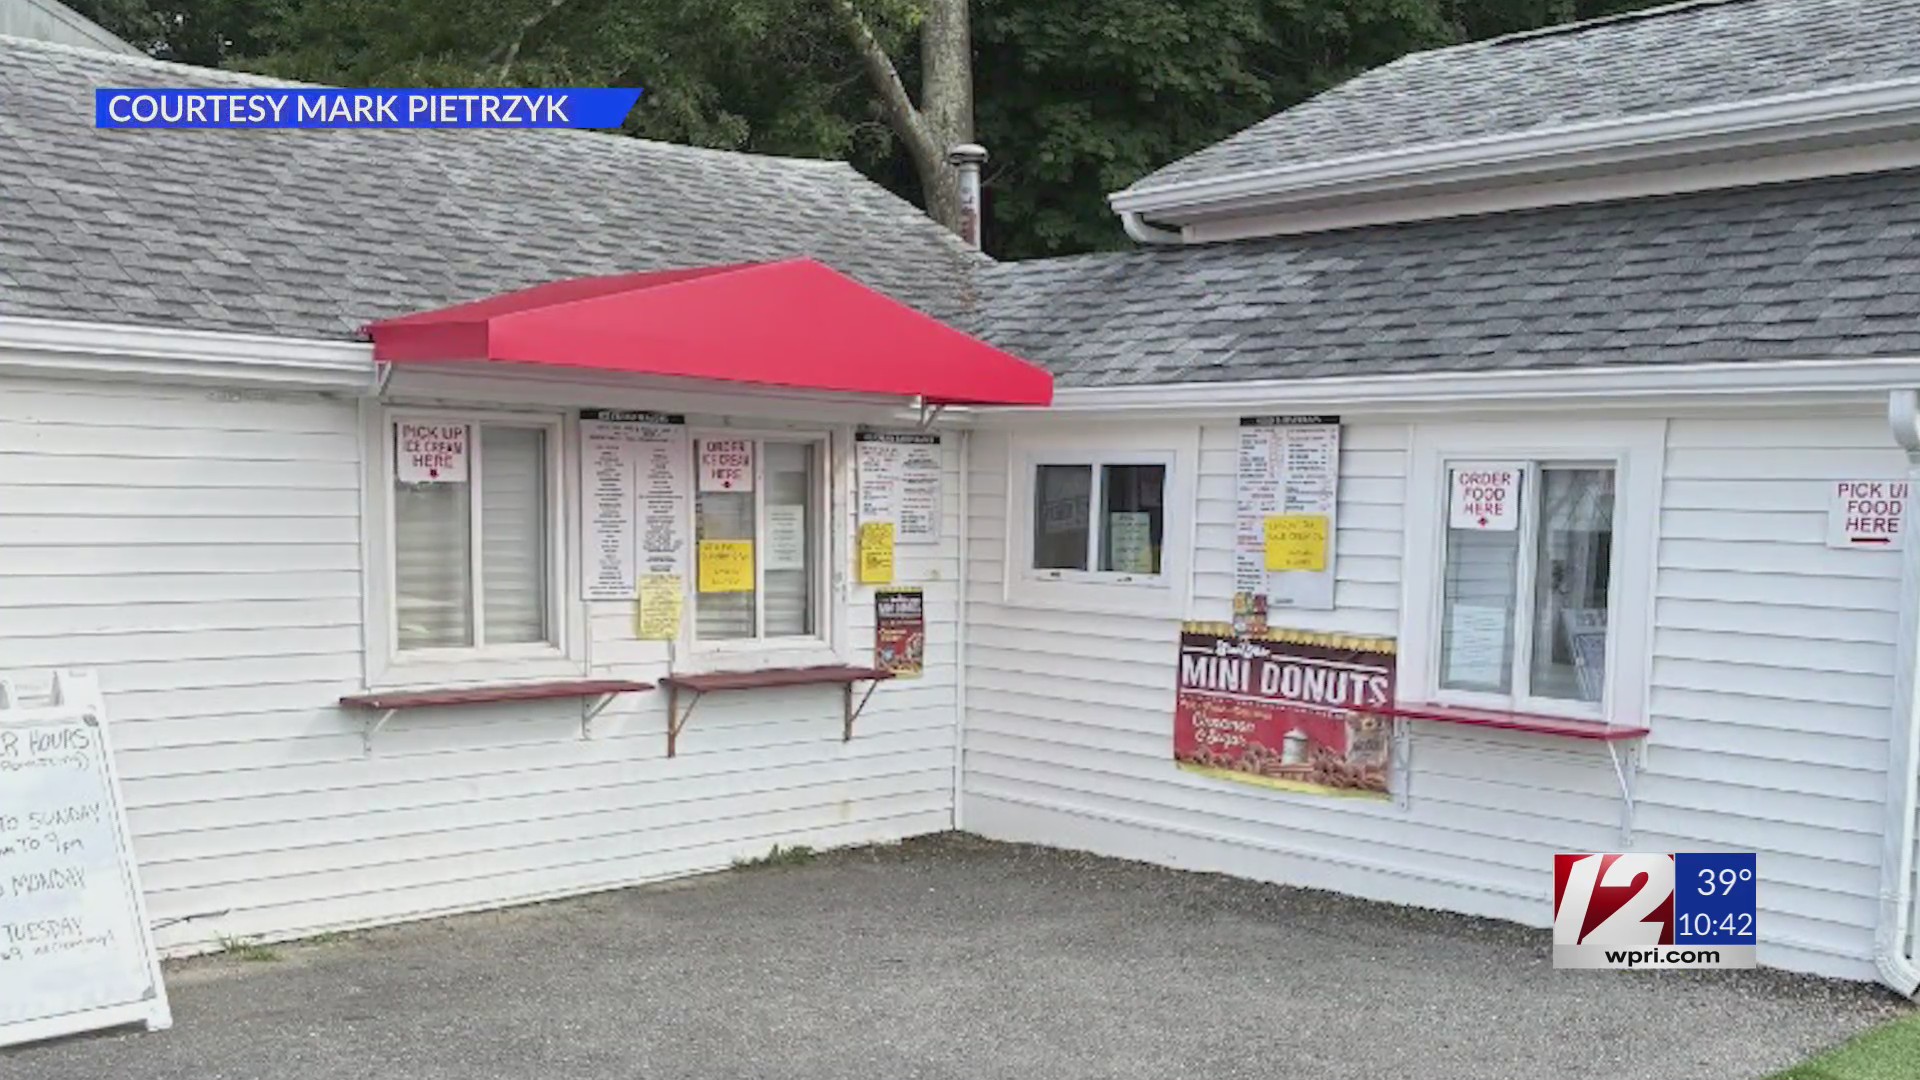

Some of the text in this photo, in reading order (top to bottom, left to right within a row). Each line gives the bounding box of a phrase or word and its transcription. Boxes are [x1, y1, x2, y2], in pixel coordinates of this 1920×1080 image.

[402, 424, 463, 440] PICK UP
[412, 454, 454, 469] HERE
[1459, 471, 1512, 486] ORDER
[1462, 487, 1506, 502] FOOD
[1837, 482, 1883, 499] PICK
[1463, 502, 1504, 517] HERE
[1847, 499, 1903, 516] FOOD
[1845, 517, 1901, 534] HERE
[1181, 653, 1388, 706] MINI DONUTS
[29, 727, 90, 756] HOURS
[28, 802, 100, 830] SUNDAY
[11, 865, 87, 897] MONDAY
[1, 916, 83, 944] TUESDAY
